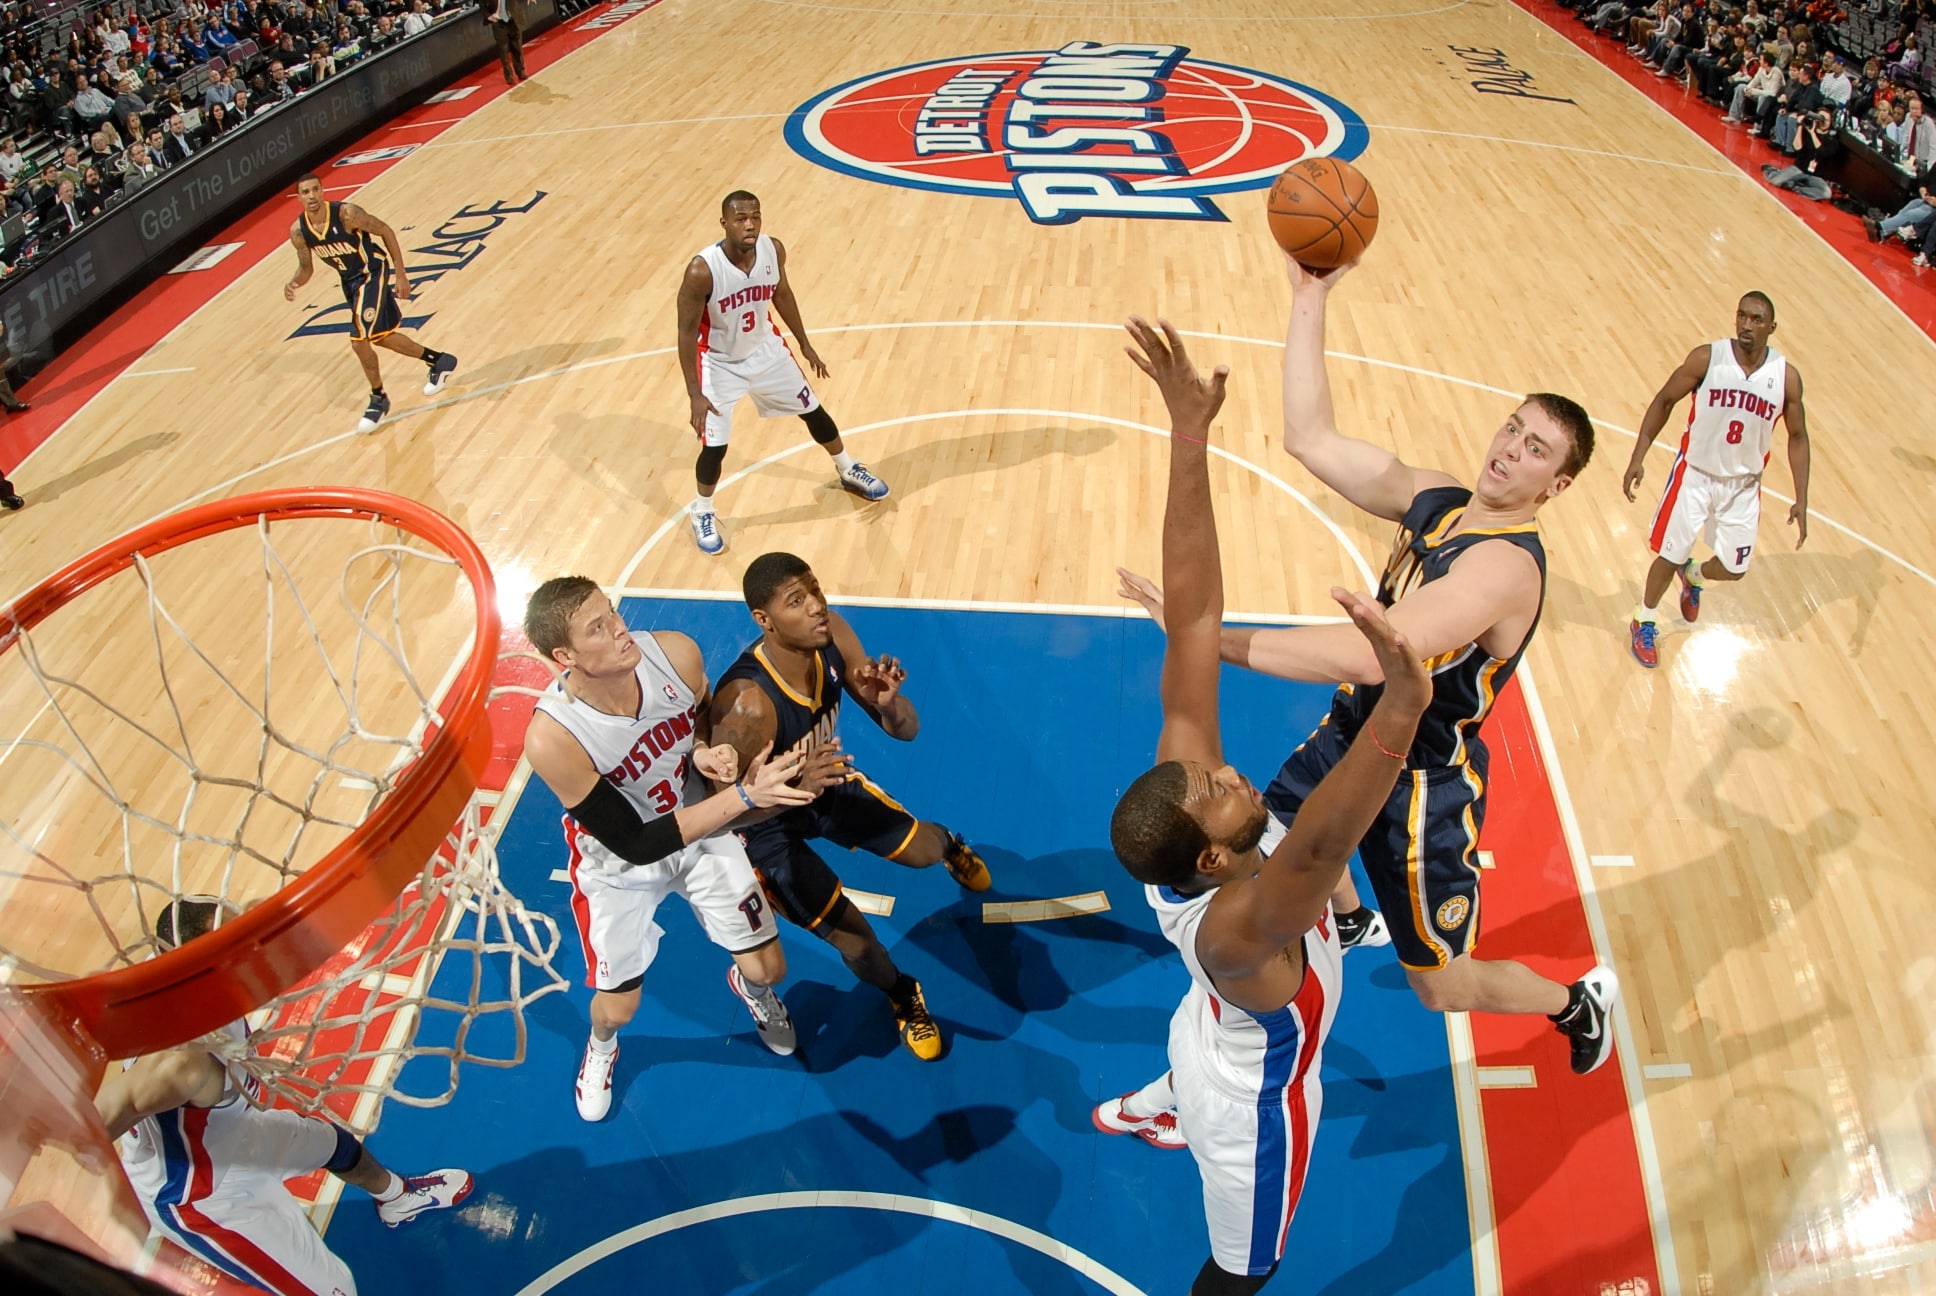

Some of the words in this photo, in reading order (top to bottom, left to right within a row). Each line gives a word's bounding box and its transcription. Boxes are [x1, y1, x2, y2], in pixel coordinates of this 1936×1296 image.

[1447, 45, 1578, 105] PALACE
[914, 67, 1021, 156] DETROIT
[1002, 40, 1232, 225] PISTONS
[140, 196, 181, 240] Get
[183, 174, 223, 211] The
[227, 126, 295, 185] Lowest
[296, 109, 329, 140] Tire
[311, 241, 358, 258] NDIANA
[333, 256, 348, 271] 3
[28, 251, 96, 320] TIRE
[718, 284, 777, 314] PISTONS
[742, 311, 755, 332] 3
[1708, 388, 1777, 422] PISTONS
[1726, 420, 1745, 445] 8
